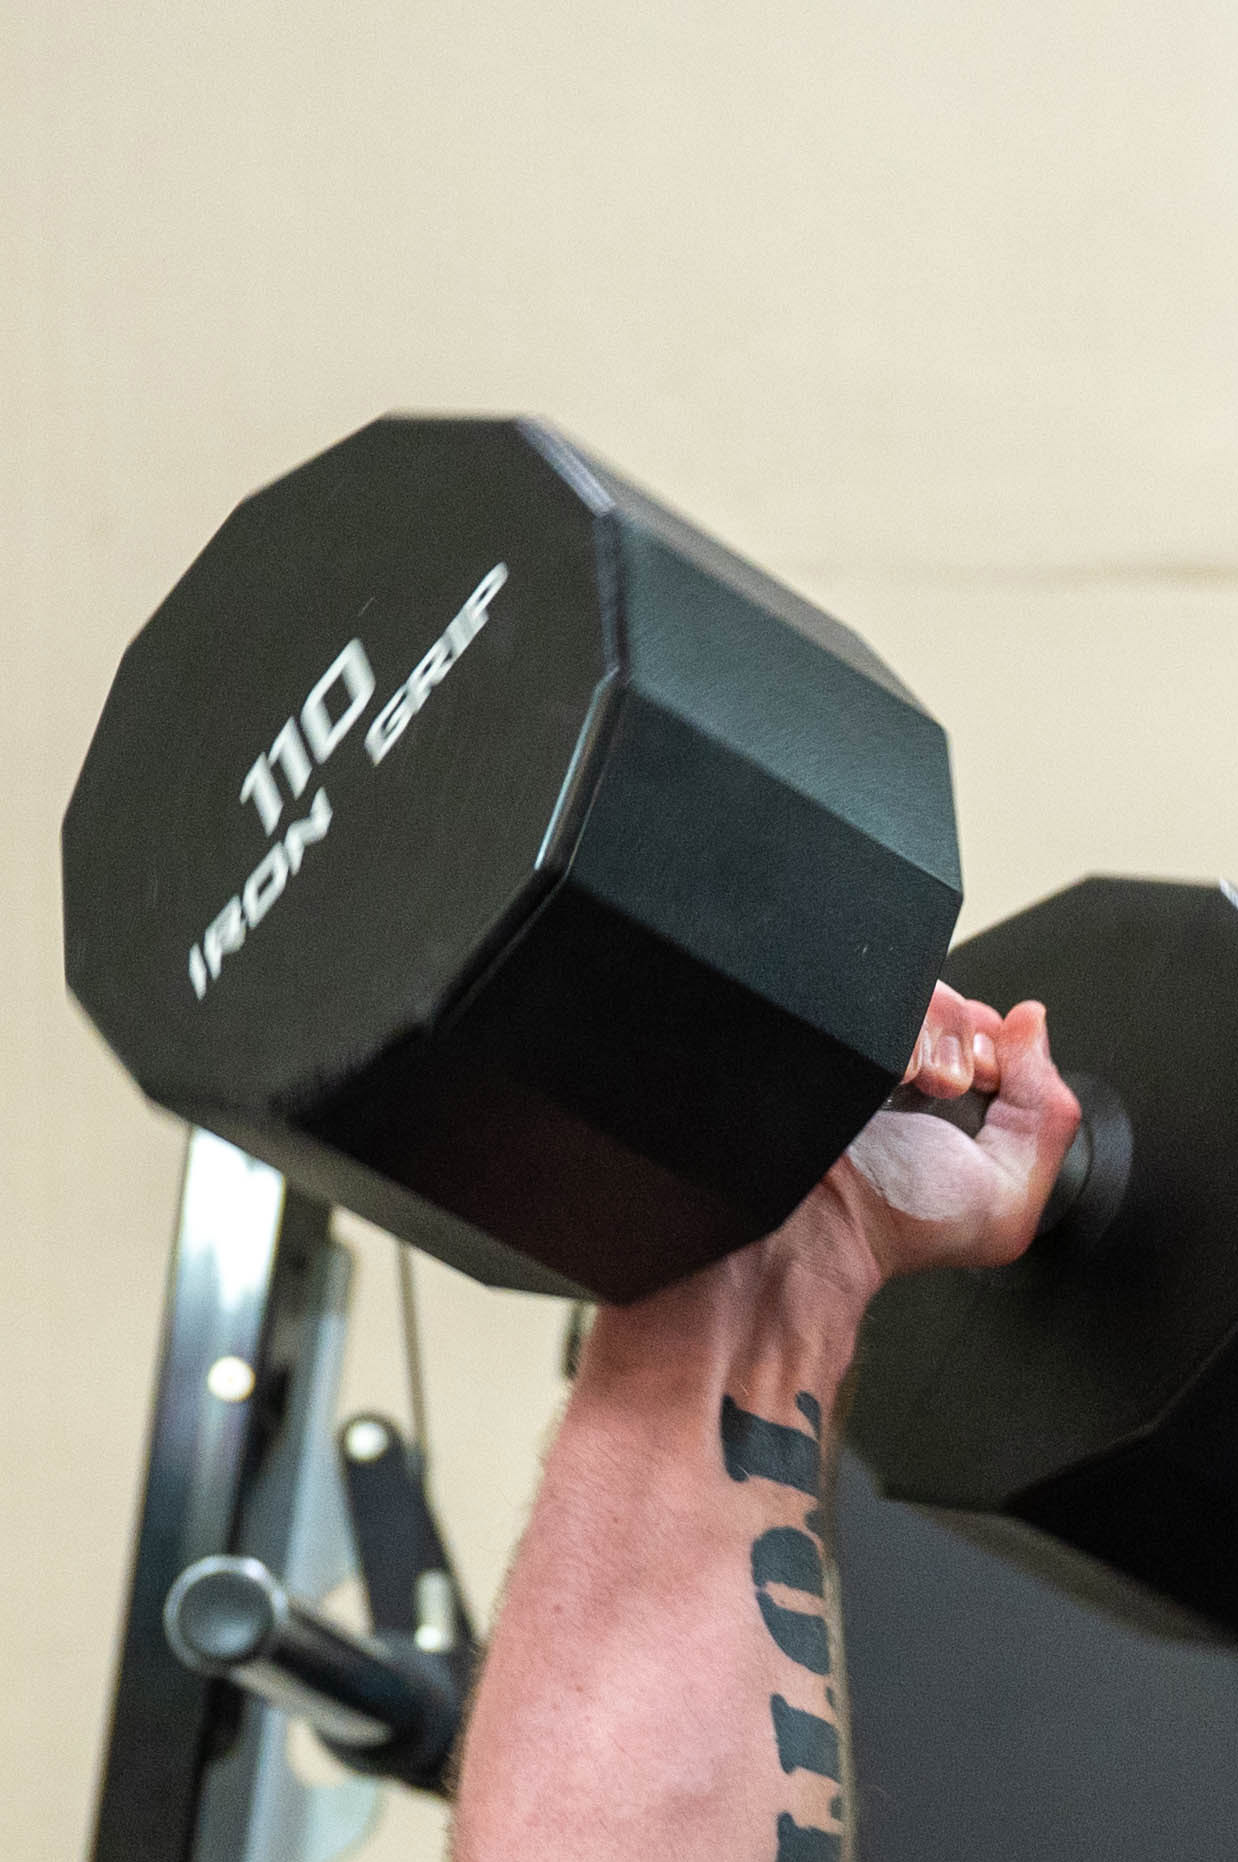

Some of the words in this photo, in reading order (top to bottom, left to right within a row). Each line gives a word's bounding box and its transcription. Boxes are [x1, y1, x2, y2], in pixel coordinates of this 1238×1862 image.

[187, 786, 335, 1001] IRON
[363, 561, 509, 767] GRIP
[239, 637, 377, 837] 110
